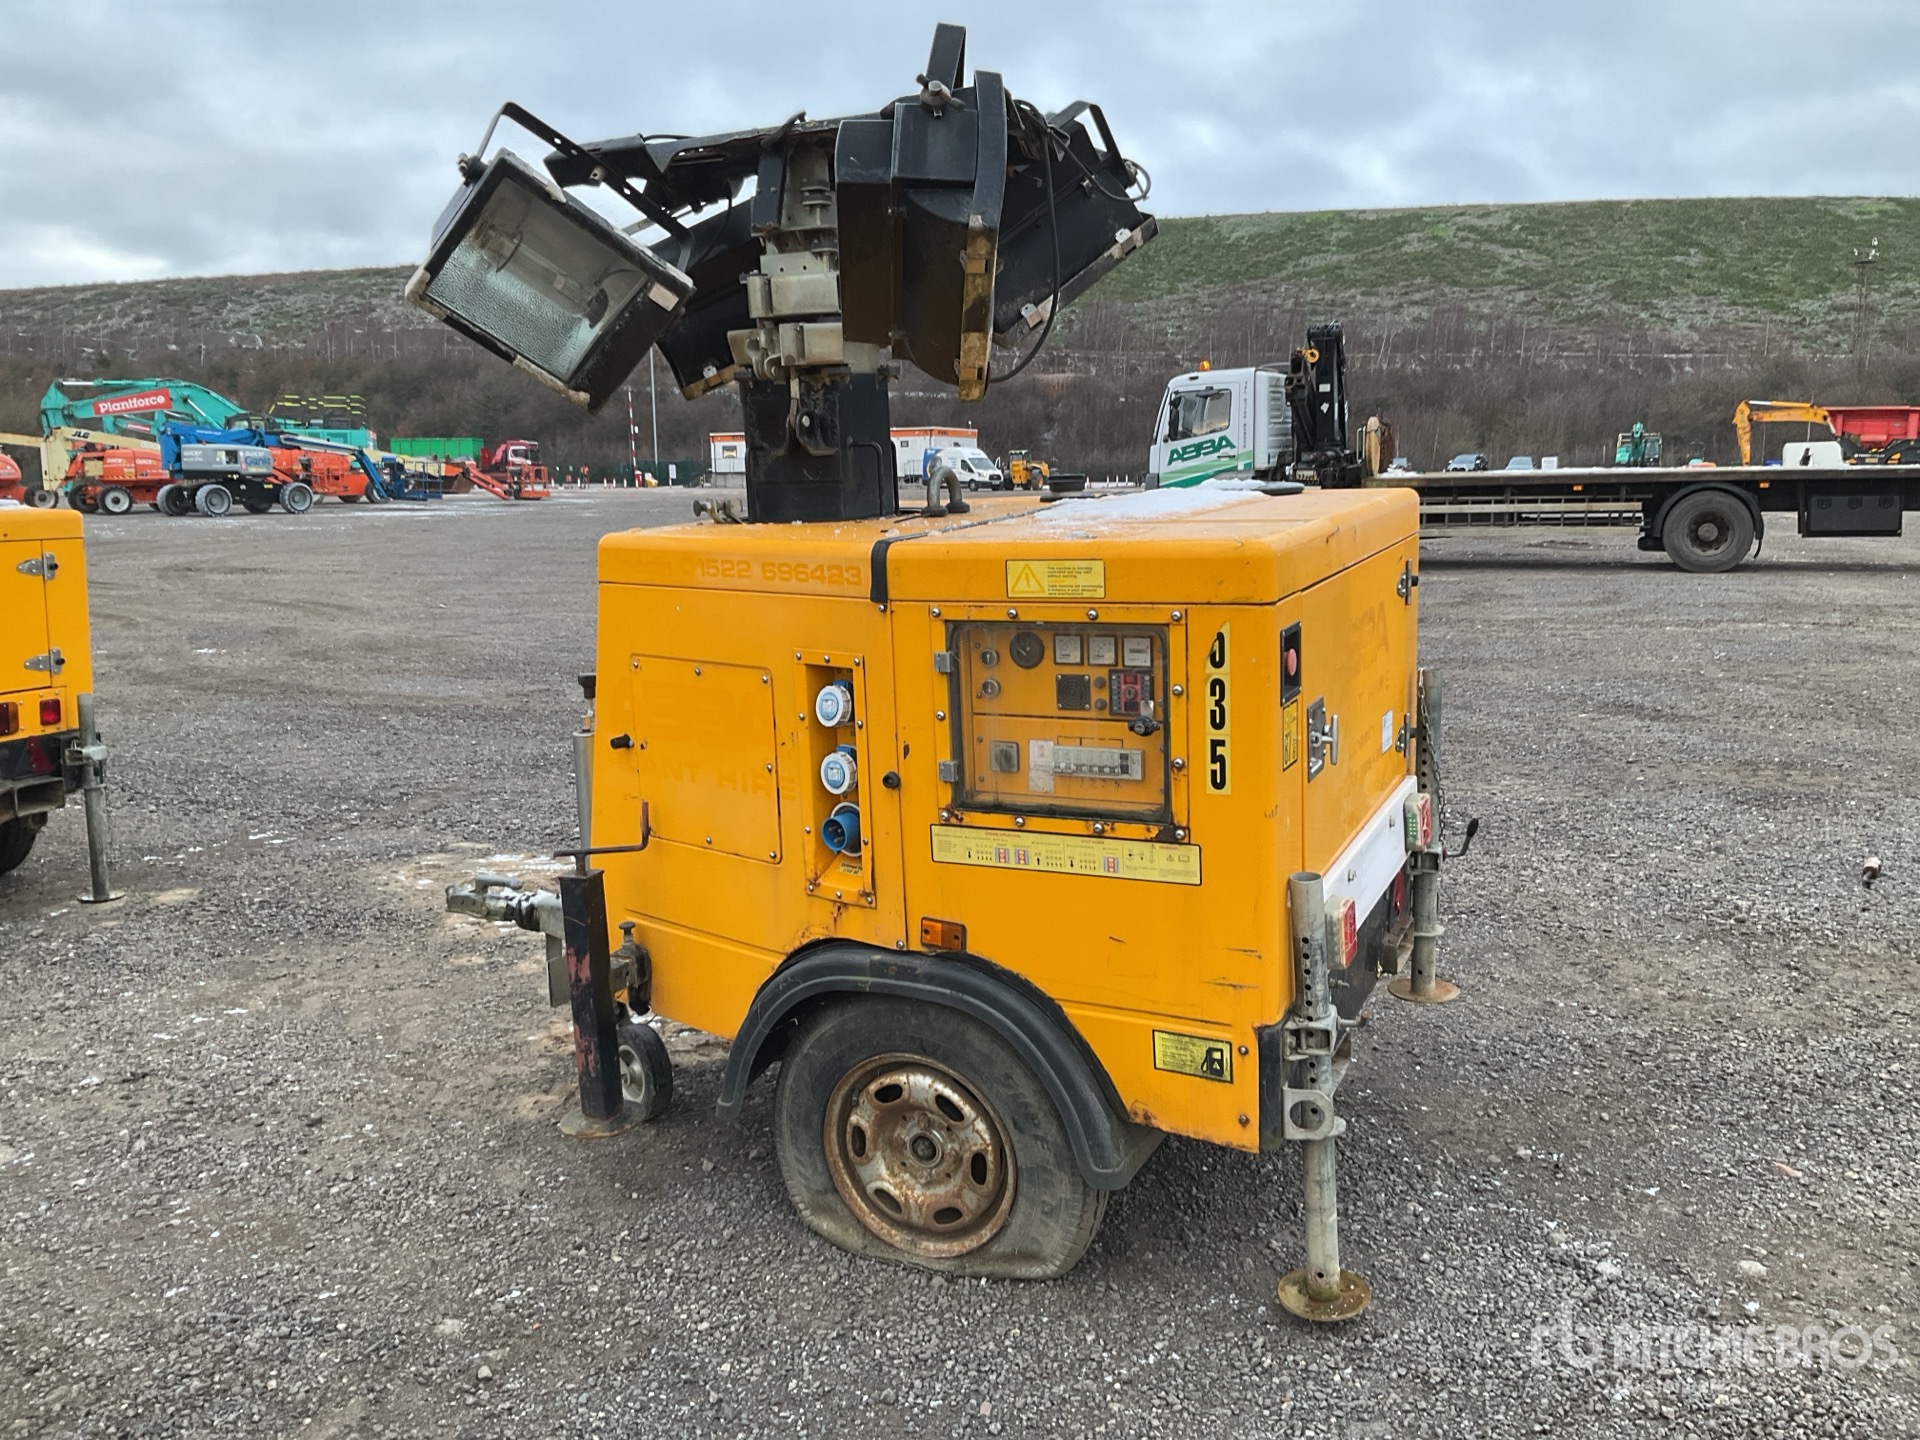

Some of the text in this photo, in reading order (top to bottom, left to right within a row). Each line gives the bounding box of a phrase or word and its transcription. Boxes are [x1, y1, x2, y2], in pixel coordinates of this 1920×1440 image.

[98, 394, 166, 414] Plantforce
[71, 430, 91, 439] JLG
[1167, 435, 1237, 466] ABBA
[244, 456, 271, 466] Genie
[760, 561, 863, 586] 696423
